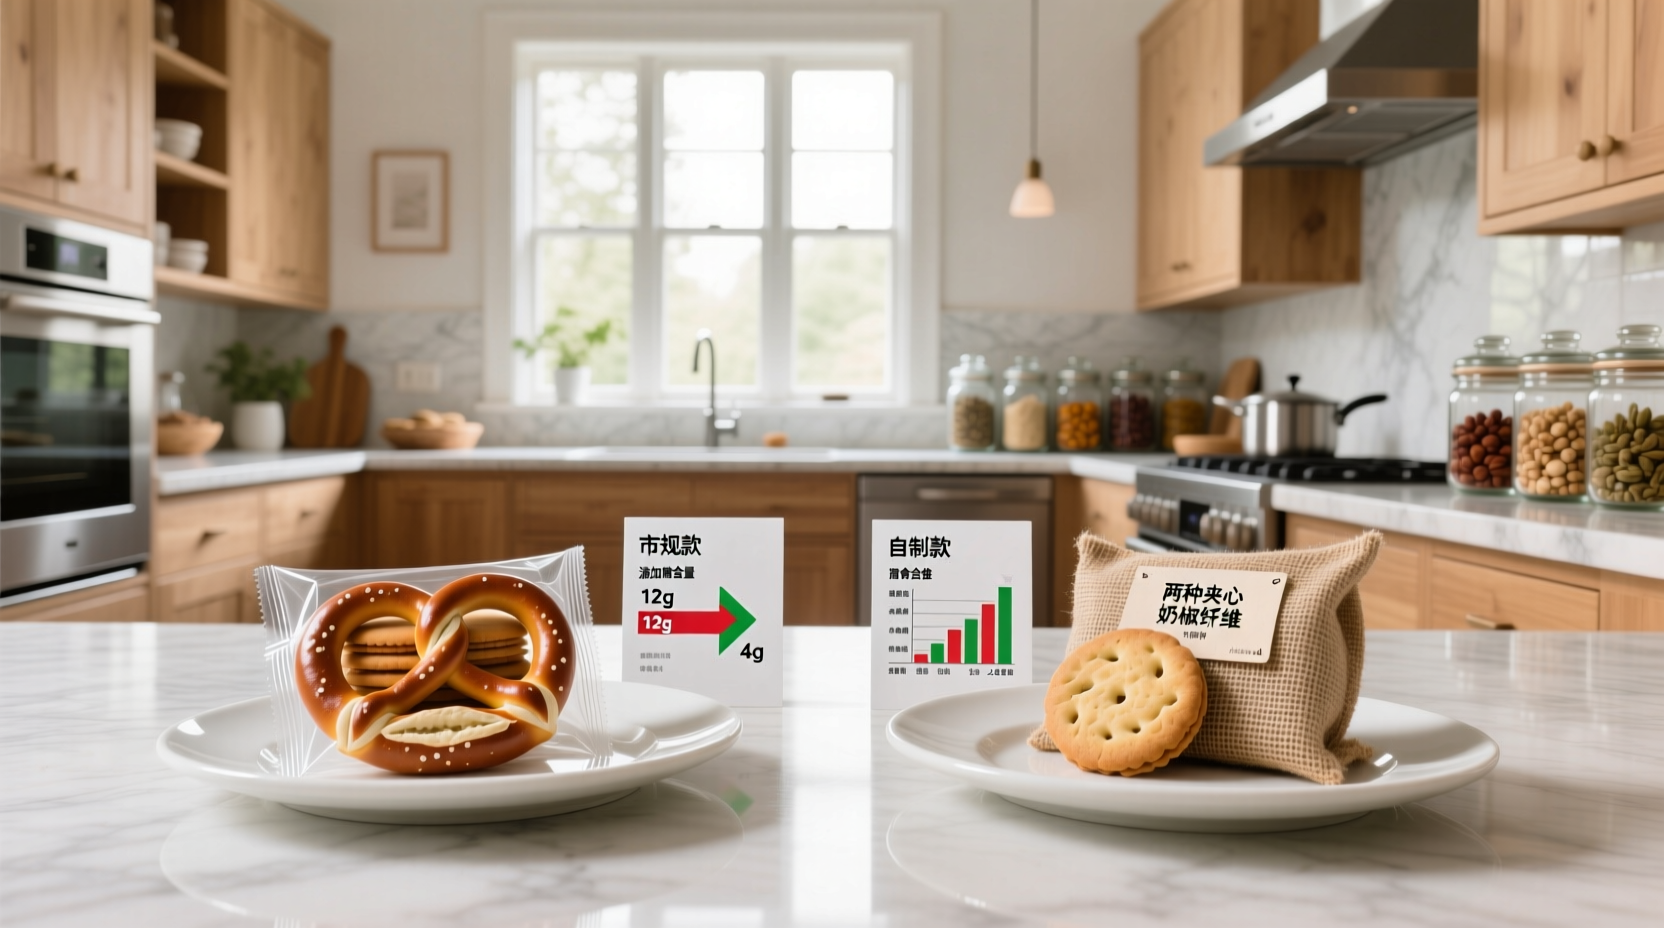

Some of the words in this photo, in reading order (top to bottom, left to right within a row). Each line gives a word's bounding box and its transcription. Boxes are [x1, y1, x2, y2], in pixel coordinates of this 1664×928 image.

[639, 534, 702, 556] 市规款
[889, 535, 951, 558] 自制款
[641, 588, 674, 609] 12g
[1162, 582, 1244, 606] 两种夹心
[642, 614, 672, 634] 12g
[740, 642, 764, 663] 4g
